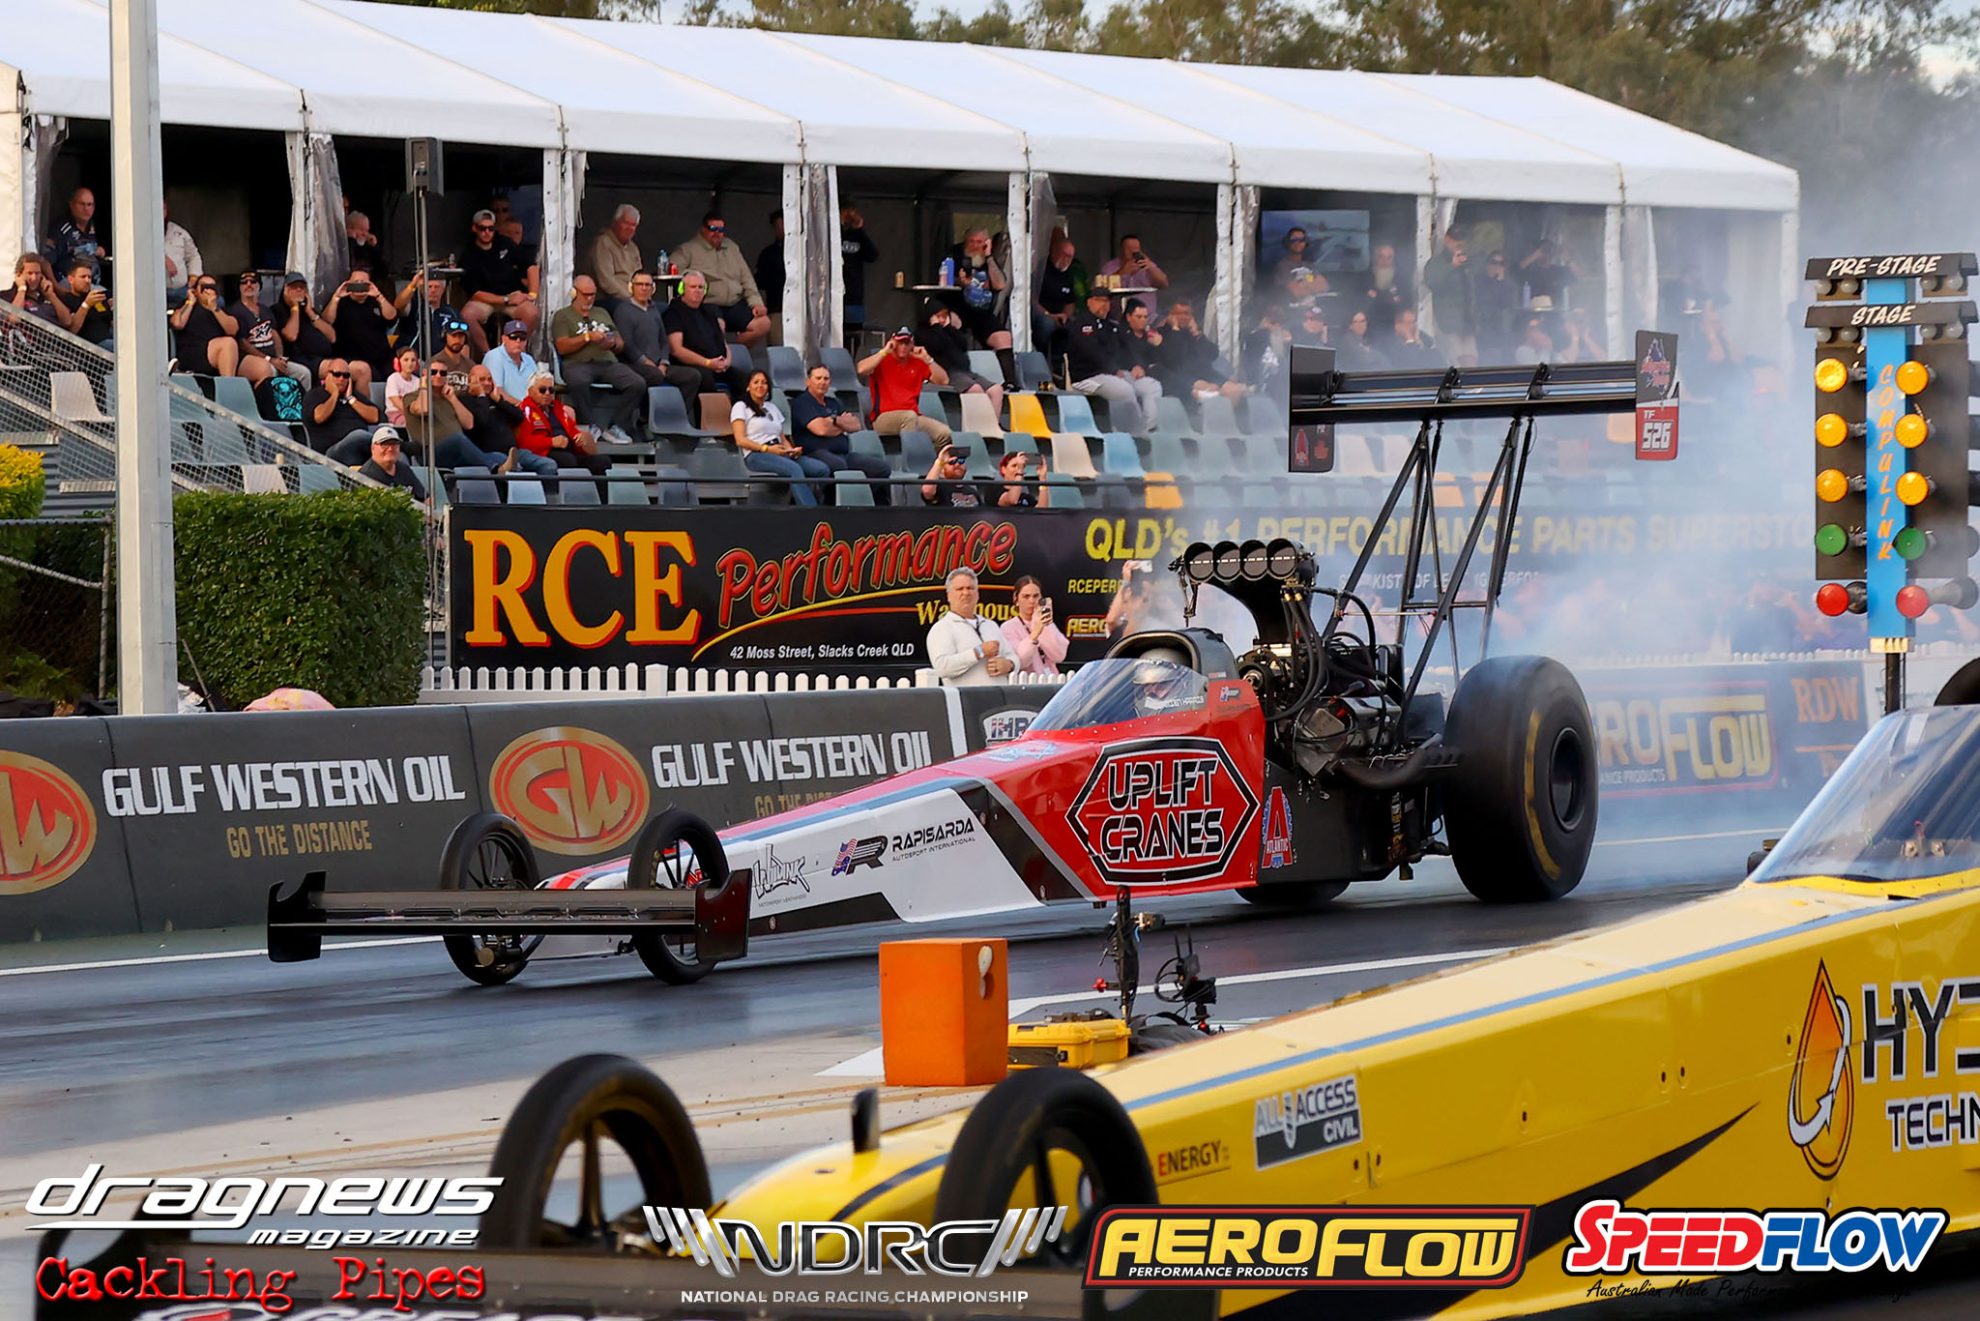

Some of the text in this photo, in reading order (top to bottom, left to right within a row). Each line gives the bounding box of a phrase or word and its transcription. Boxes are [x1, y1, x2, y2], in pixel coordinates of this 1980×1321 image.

[1826, 255, 1941, 277] PRE-STAGE
[1851, 305, 1916, 326] STAGE
[1642, 421, 1673, 451] 526
[1644, 410, 1656, 419] TF
[1876, 363, 1895, 561] COMPULINK
[1085, 518, 1189, 562] QLD's
[1532, 516, 1636, 554] PARTS
[464, 529, 701, 648] RCE
[716, 520, 1018, 629] Performance
[730, 643, 914, 660] 42 Moss Street, Slacks Creek QLD
[1791, 676, 1859, 723] RDW
[651, 740, 735, 789] GULF
[739, 733, 888, 783] WESTERN
[102, 754, 466, 818] GULF WESTERN OIL
[1109, 756, 1219, 812] UPLIFT
[226, 819, 373, 859] GO THE DISTANCE
[892, 817, 975, 852] RAPISARDA
[892, 837, 976, 862] AUTOSPORT INTERNATIONAL
[1101, 807, 1224, 864] CRANES
[1256, 1078, 1357, 1136] ALL ACCESS
[1324, 1117, 1359, 1143] CIVIL
[1158, 1140, 1222, 1177] ENERGY
